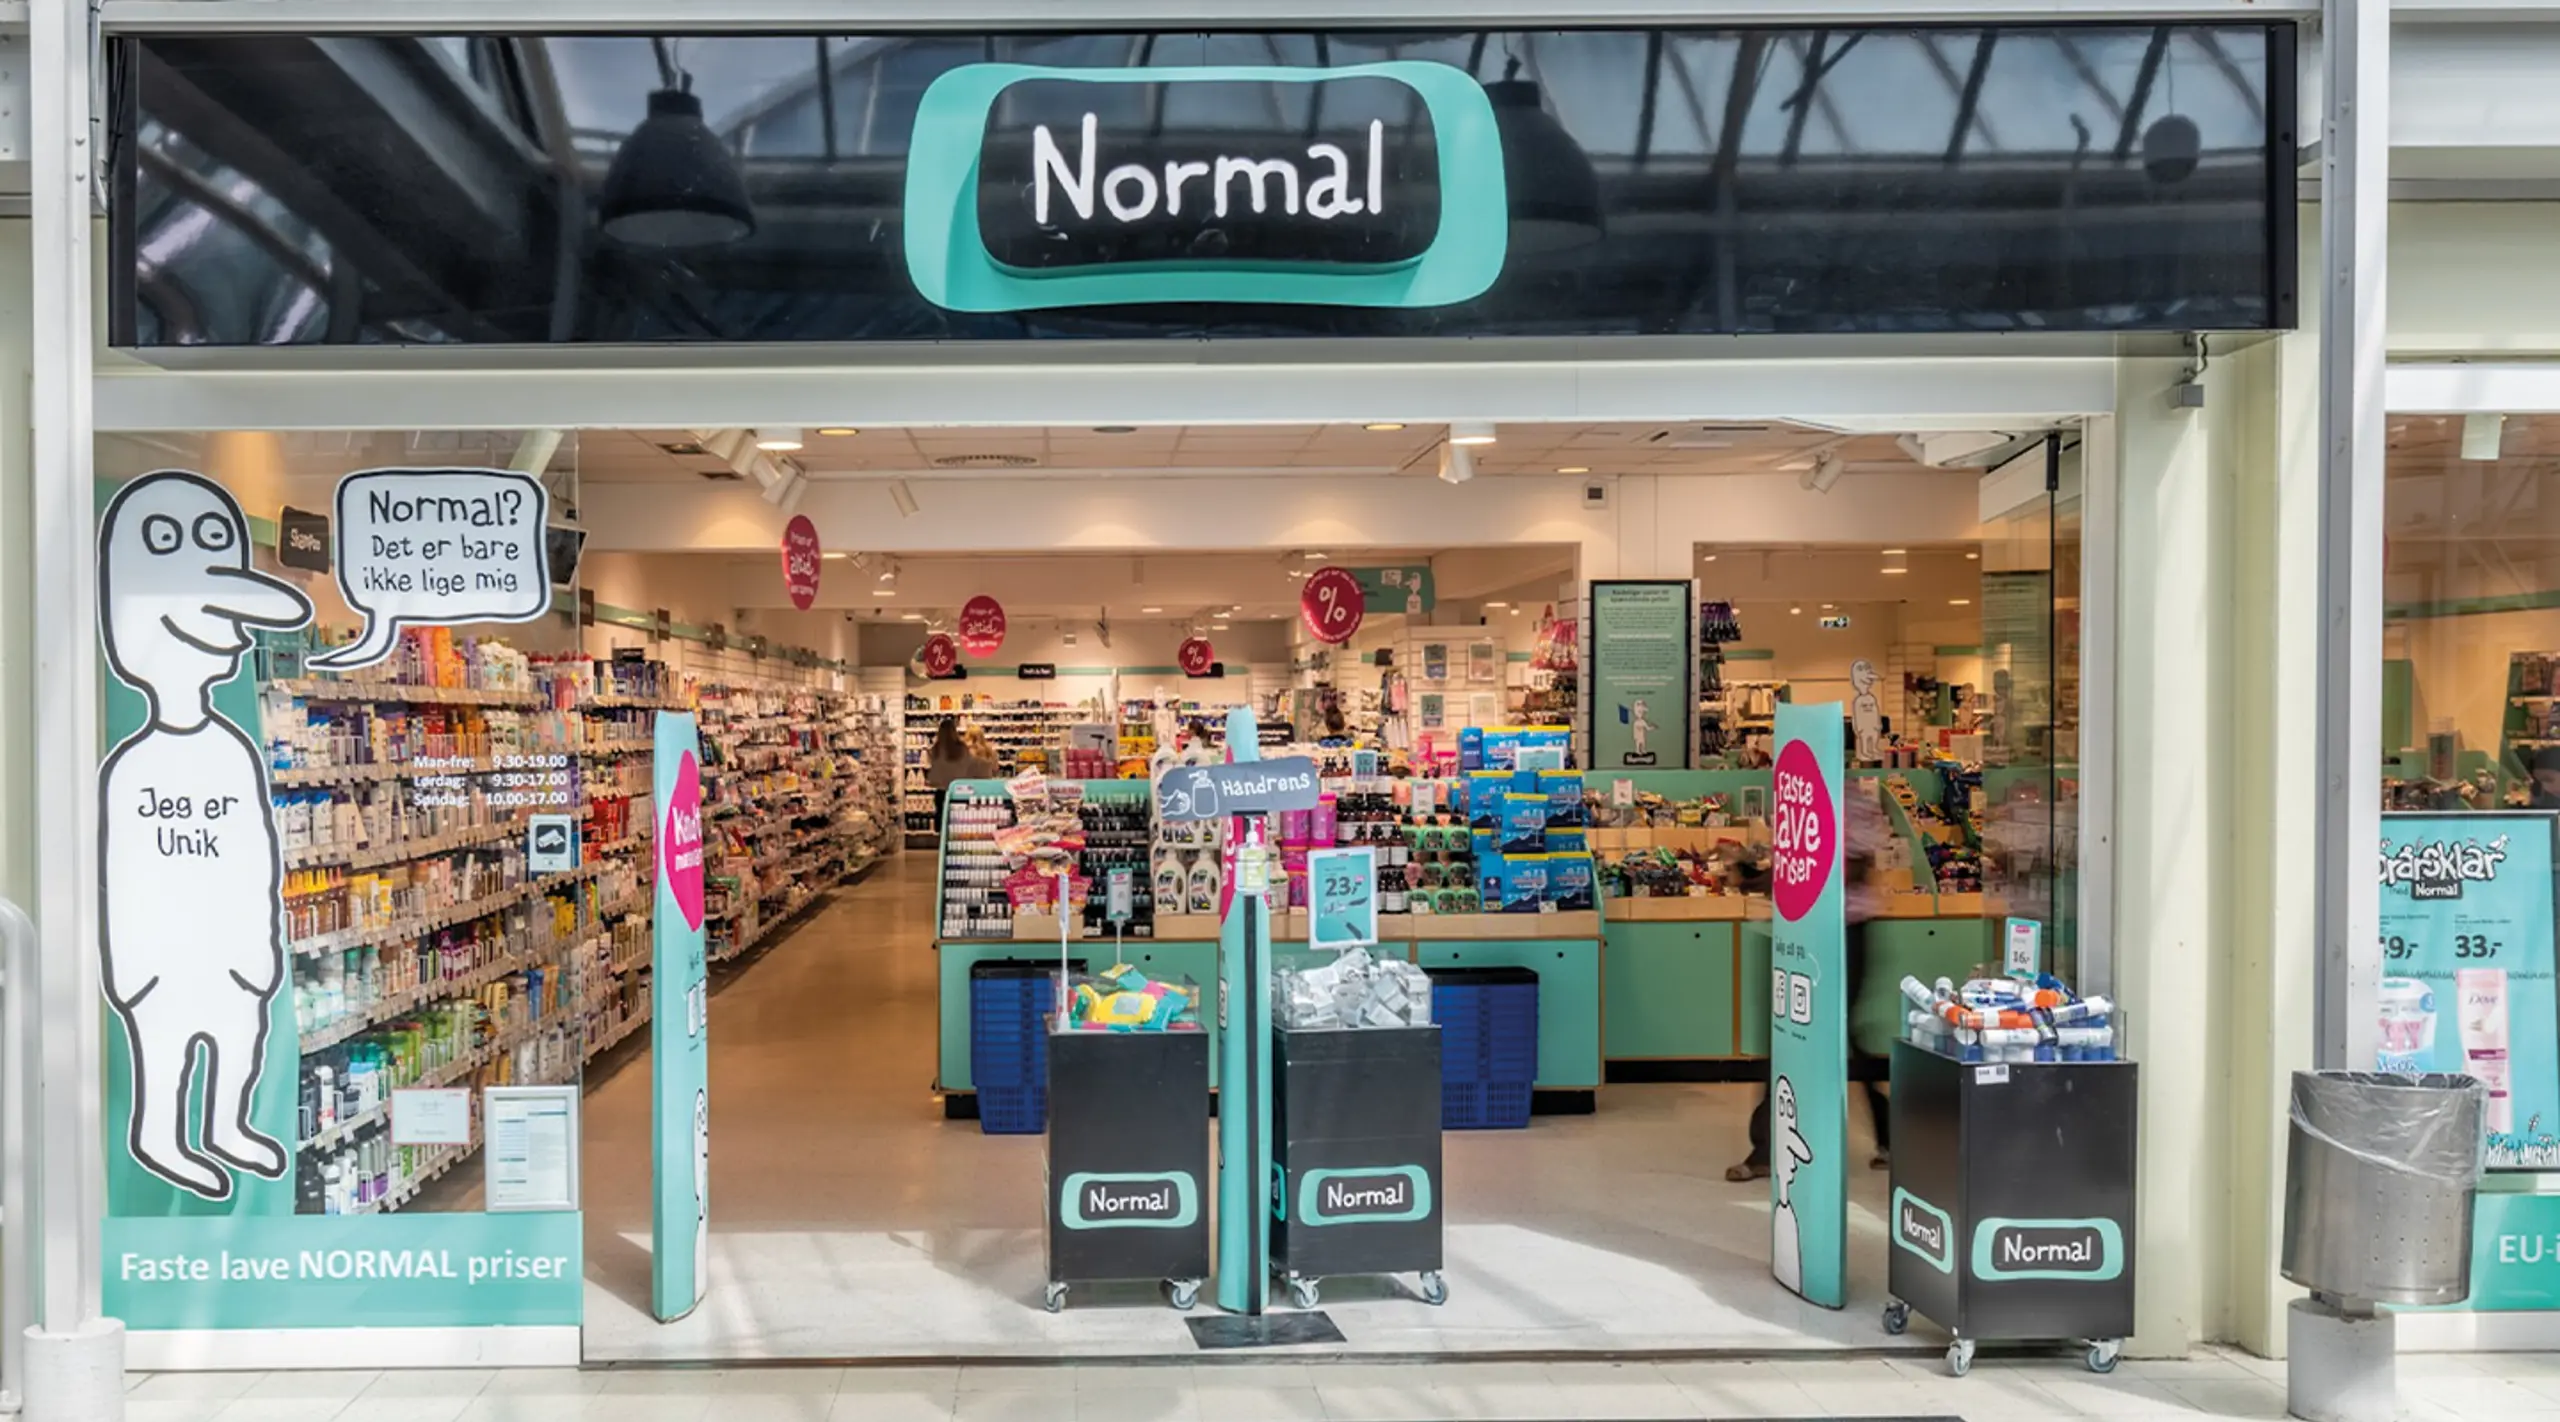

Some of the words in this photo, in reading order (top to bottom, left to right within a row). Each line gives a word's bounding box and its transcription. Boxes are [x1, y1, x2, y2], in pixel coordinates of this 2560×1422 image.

[1033, 112, 1383, 224] Normal
[369, 489, 522, 526] Normal?
[371, 534, 413, 559] Det
[422, 539, 452, 560] er
[461, 534, 519, 560] bare
[363, 566, 412, 592] ikke
[422, 568, 465, 596] lige
[476, 569, 517, 592] mig
[413, 756, 475, 769] Man-fre:
[492, 755, 568, 768] 9.30-19.00
[413, 775, 466, 792] Lørdag:
[492, 774, 568, 787] 9.30-17.00
[138, 787, 193, 819] Jeg
[204, 796, 239, 820] er
[413, 793, 470, 811] Søndag:
[486, 792, 568, 805] 10.00-17.00
[157, 826, 220, 858] Unik
[2415, 882, 2458, 897] Normal
[2455, 935, 2502, 959] 33,-
[1090, 1187, 1169, 1213] Normal
[1327, 1182, 1404, 1208] Normal
[1904, 1208, 1941, 1250] Normal
[2004, 1233, 2092, 1262] Normal
[121, 1252, 209, 1281] Faste
[221, 1251, 290, 1280] lave
[300, 1250, 457, 1280] NORMAL
[468, 1249, 568, 1284] priser
